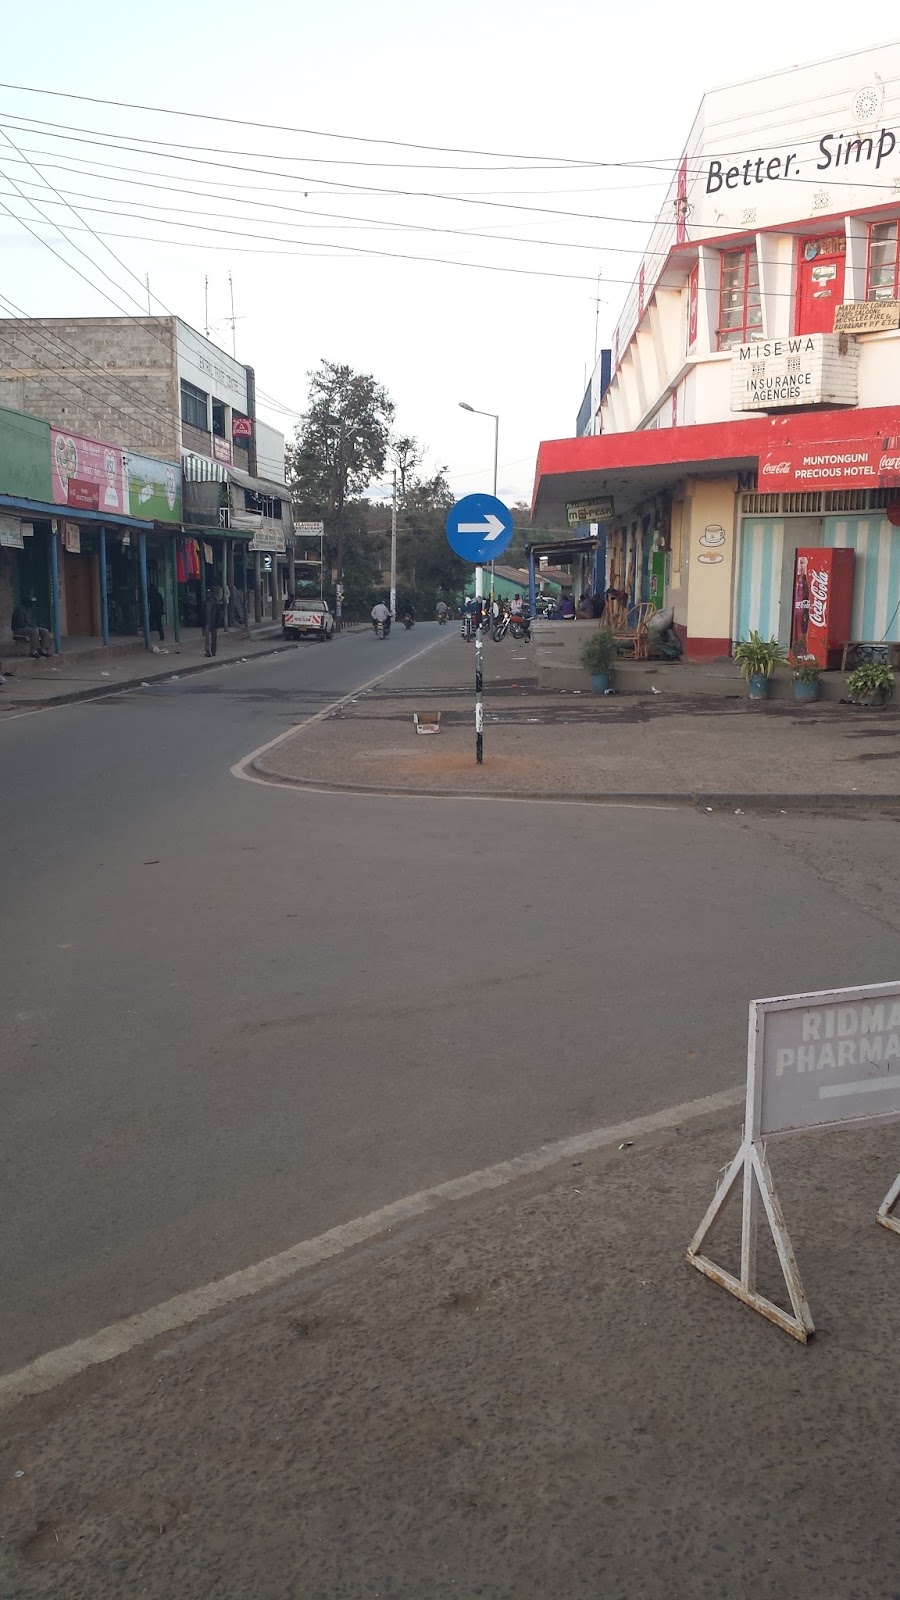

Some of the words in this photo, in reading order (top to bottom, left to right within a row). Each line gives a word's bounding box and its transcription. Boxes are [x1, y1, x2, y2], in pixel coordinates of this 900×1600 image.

[705, 151, 800, 194] Better.
[816, 128, 900, 170] Simp
[747, 373, 811, 391] INSURANCE
[753, 387, 800, 401] AGENCIES
[803, 453, 868, 466] MUNTONGUNI
[795, 468, 841, 479] PRECIOUS
[844, 466, 876, 476] HOTEL
[809, 569, 829, 627] Coca-Cola
